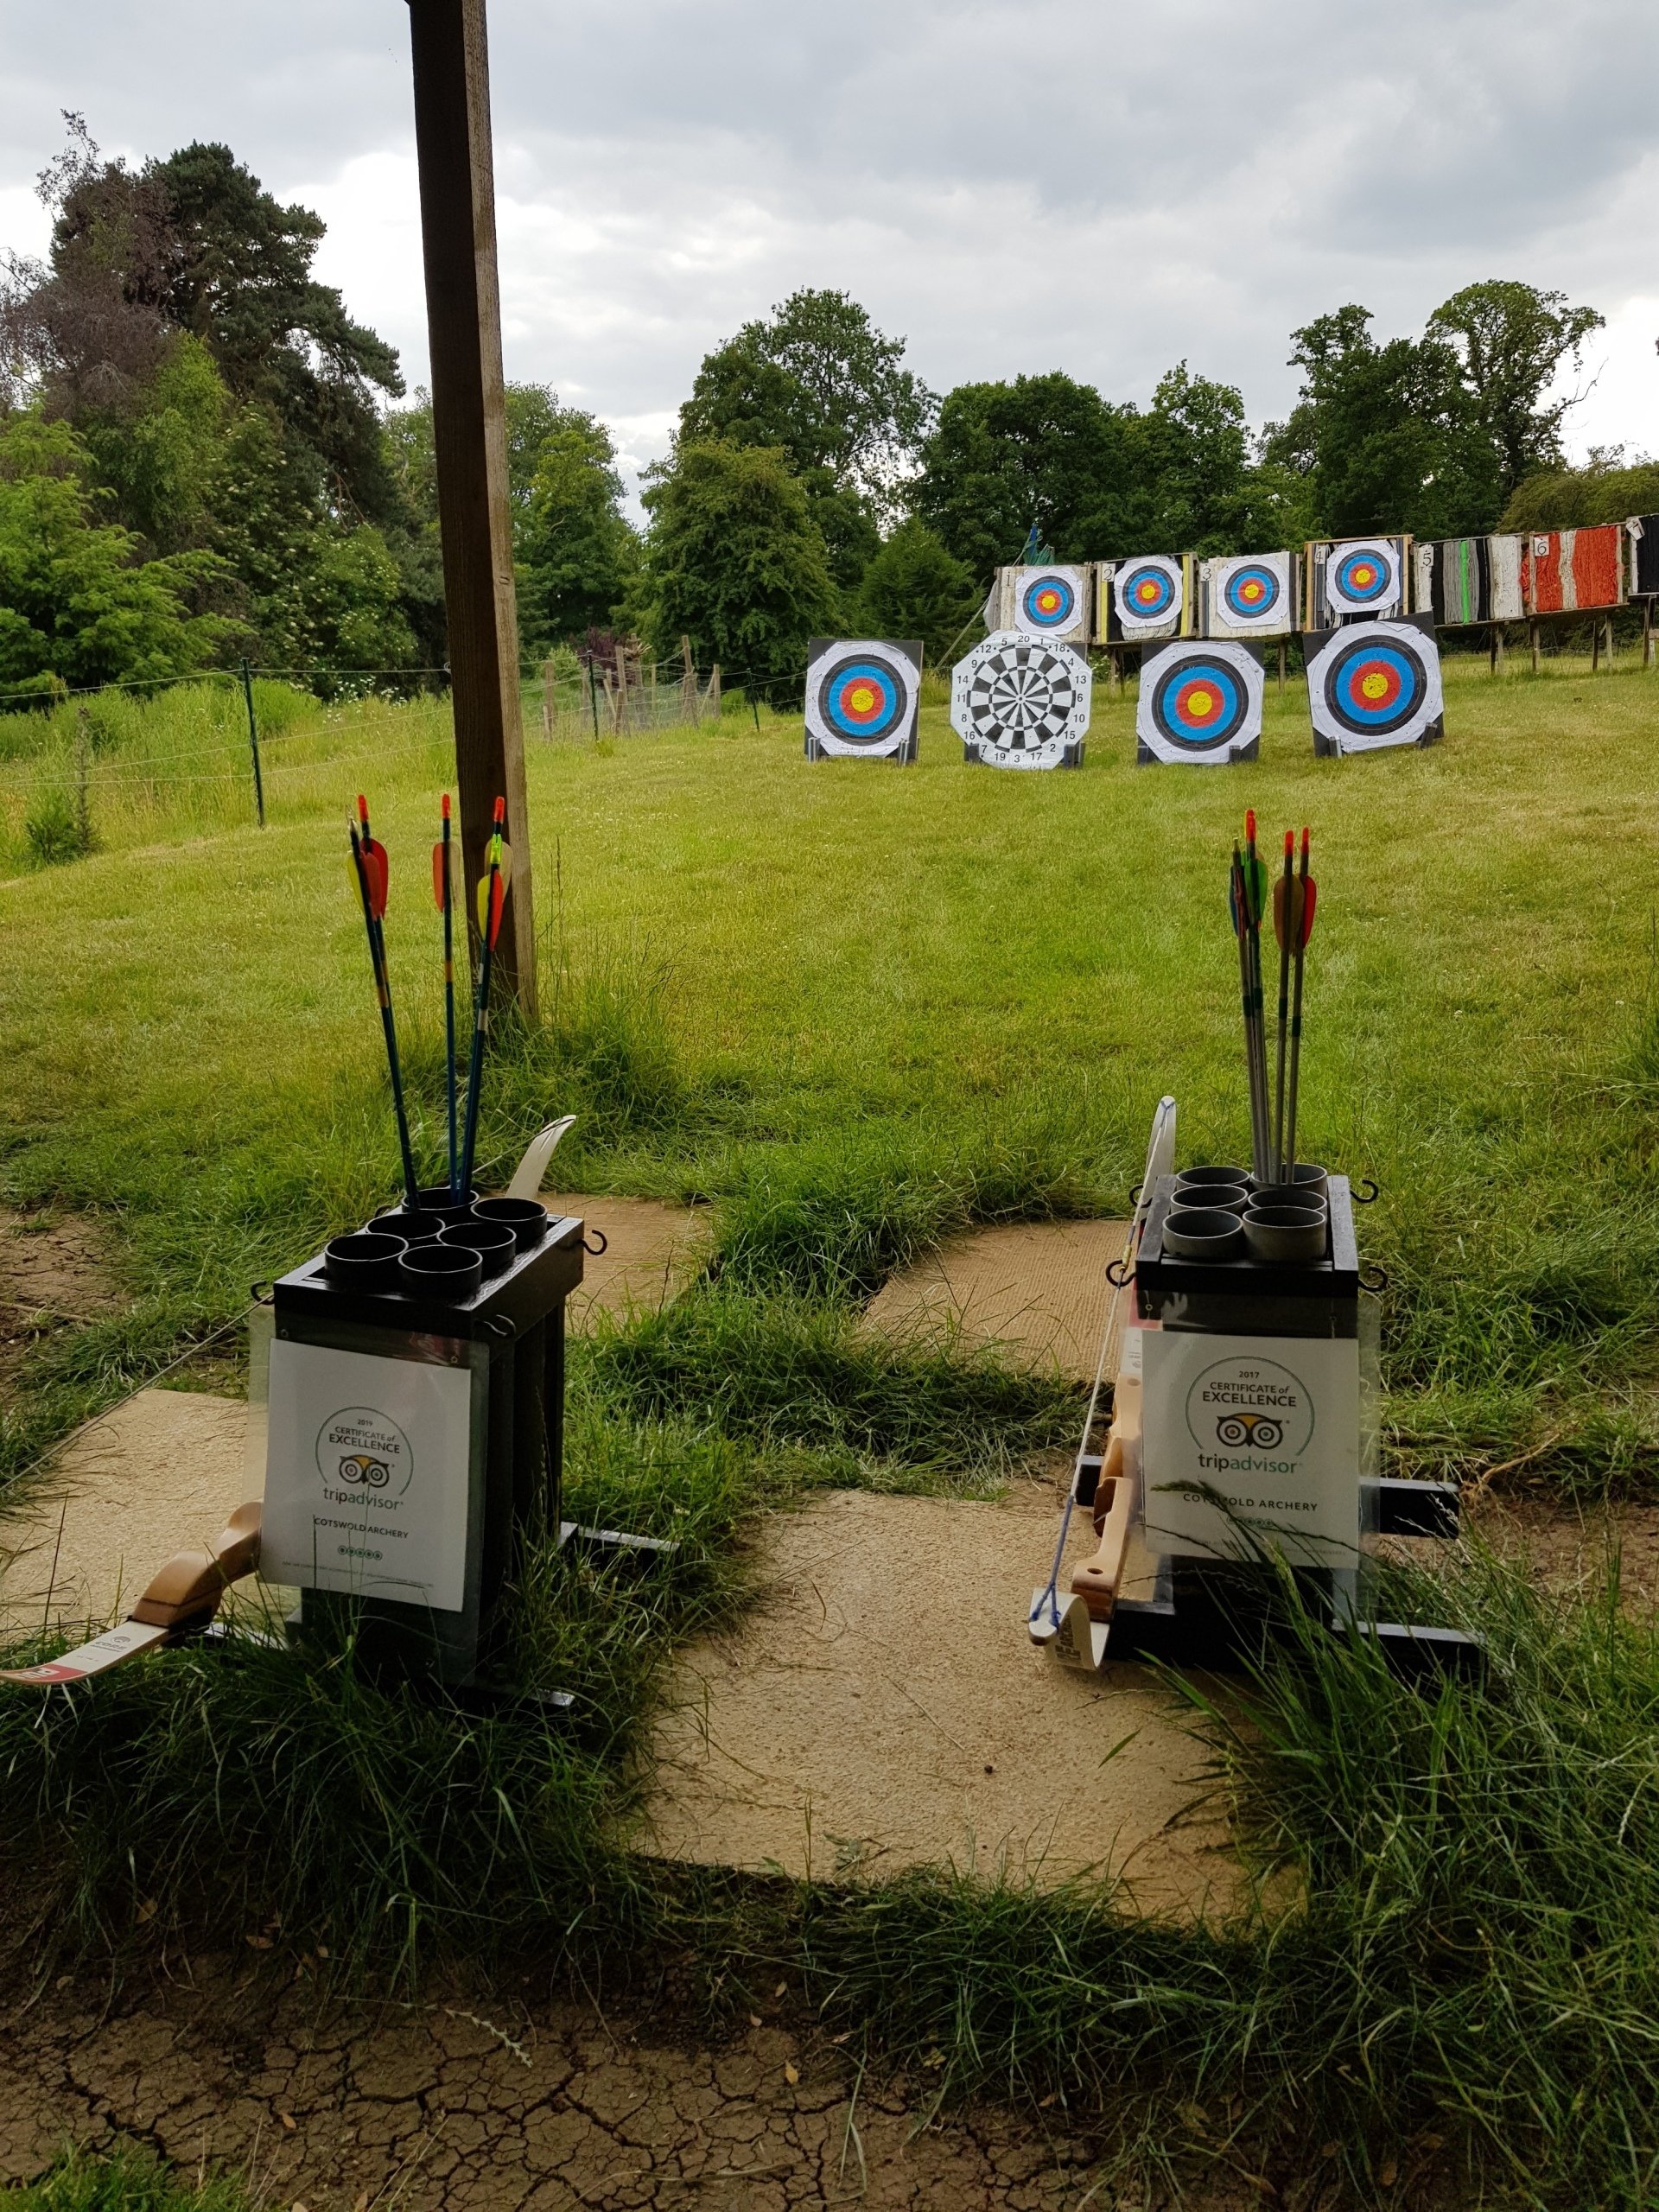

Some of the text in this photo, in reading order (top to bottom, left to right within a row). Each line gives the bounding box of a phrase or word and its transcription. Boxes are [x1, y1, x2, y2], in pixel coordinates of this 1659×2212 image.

[1537, 541, 1547, 555] 6
[1315, 551, 1323, 563] 4
[1422, 553, 1432, 566] 5
[1104, 569, 1113, 581] 2
[1203, 568, 1211, 580] 3
[980, 645, 992, 653] 12
[1054, 644, 1065, 652] 18
[971, 659, 977, 668] 9
[956, 694, 966, 702] 11
[961, 714, 967, 722] 8
[1074, 714, 1085, 722] 10
[981, 745, 988, 753] 7
[995, 753, 1006, 761] 19
[1210, 1382, 1290, 1394] CERTIFICATE of
[1202, 1391, 1297, 1407] EXCELLENCE
[335, 1427, 385, 1440] CERTIFICATE
[328, 1433, 400, 1453] EXCELLENCE
[1198, 1453, 1298, 1473] tripadvisor
[323, 1488, 400, 1510] tripadvisor
[1183, 1493, 1318, 1511] COOLD ARCHERY
[314, 1517, 409, 1538] COTSWOLD ARCHERY
